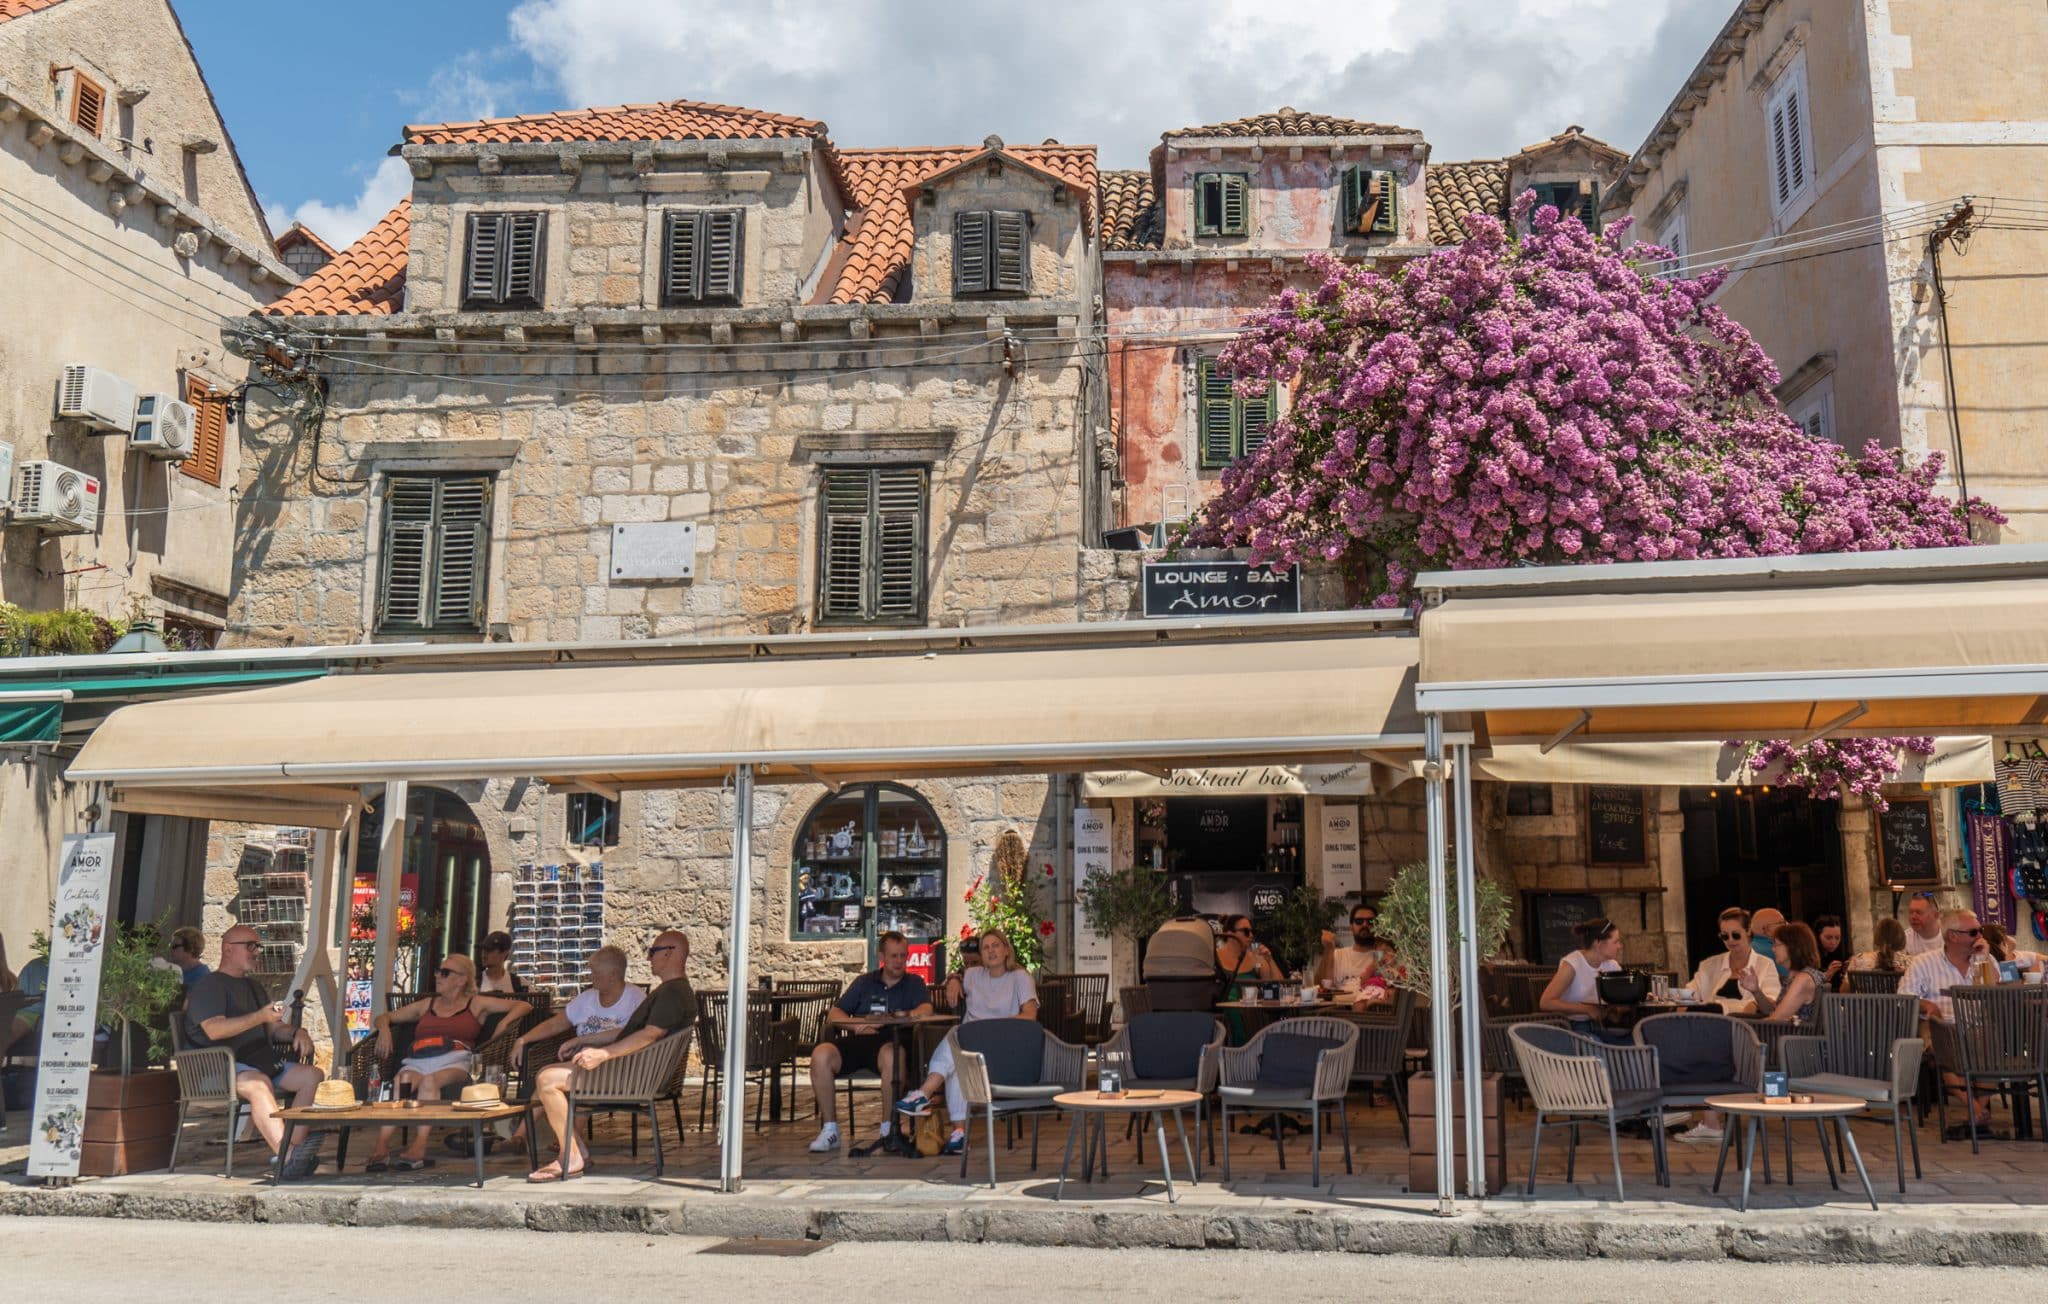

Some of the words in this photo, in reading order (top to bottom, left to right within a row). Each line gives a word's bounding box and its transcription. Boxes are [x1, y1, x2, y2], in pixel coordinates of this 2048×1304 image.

[1155, 571, 1228, 584] LOUNGE
[1247, 570, 1290, 583] BAR
[1168, 589, 1278, 610] Amor
[1258, 767, 1294, 786] bar
[1081, 822, 1104, 830] AMOR
[1200, 815, 1229, 827] AMOR
[1328, 819, 1351, 828] AMOR
[71, 856, 101, 868] AMOR
[1984, 834, 1997, 895] DUBROVNIK
[64, 888, 101, 902] Cocktails
[1253, 894, 1283, 906] AMOR
